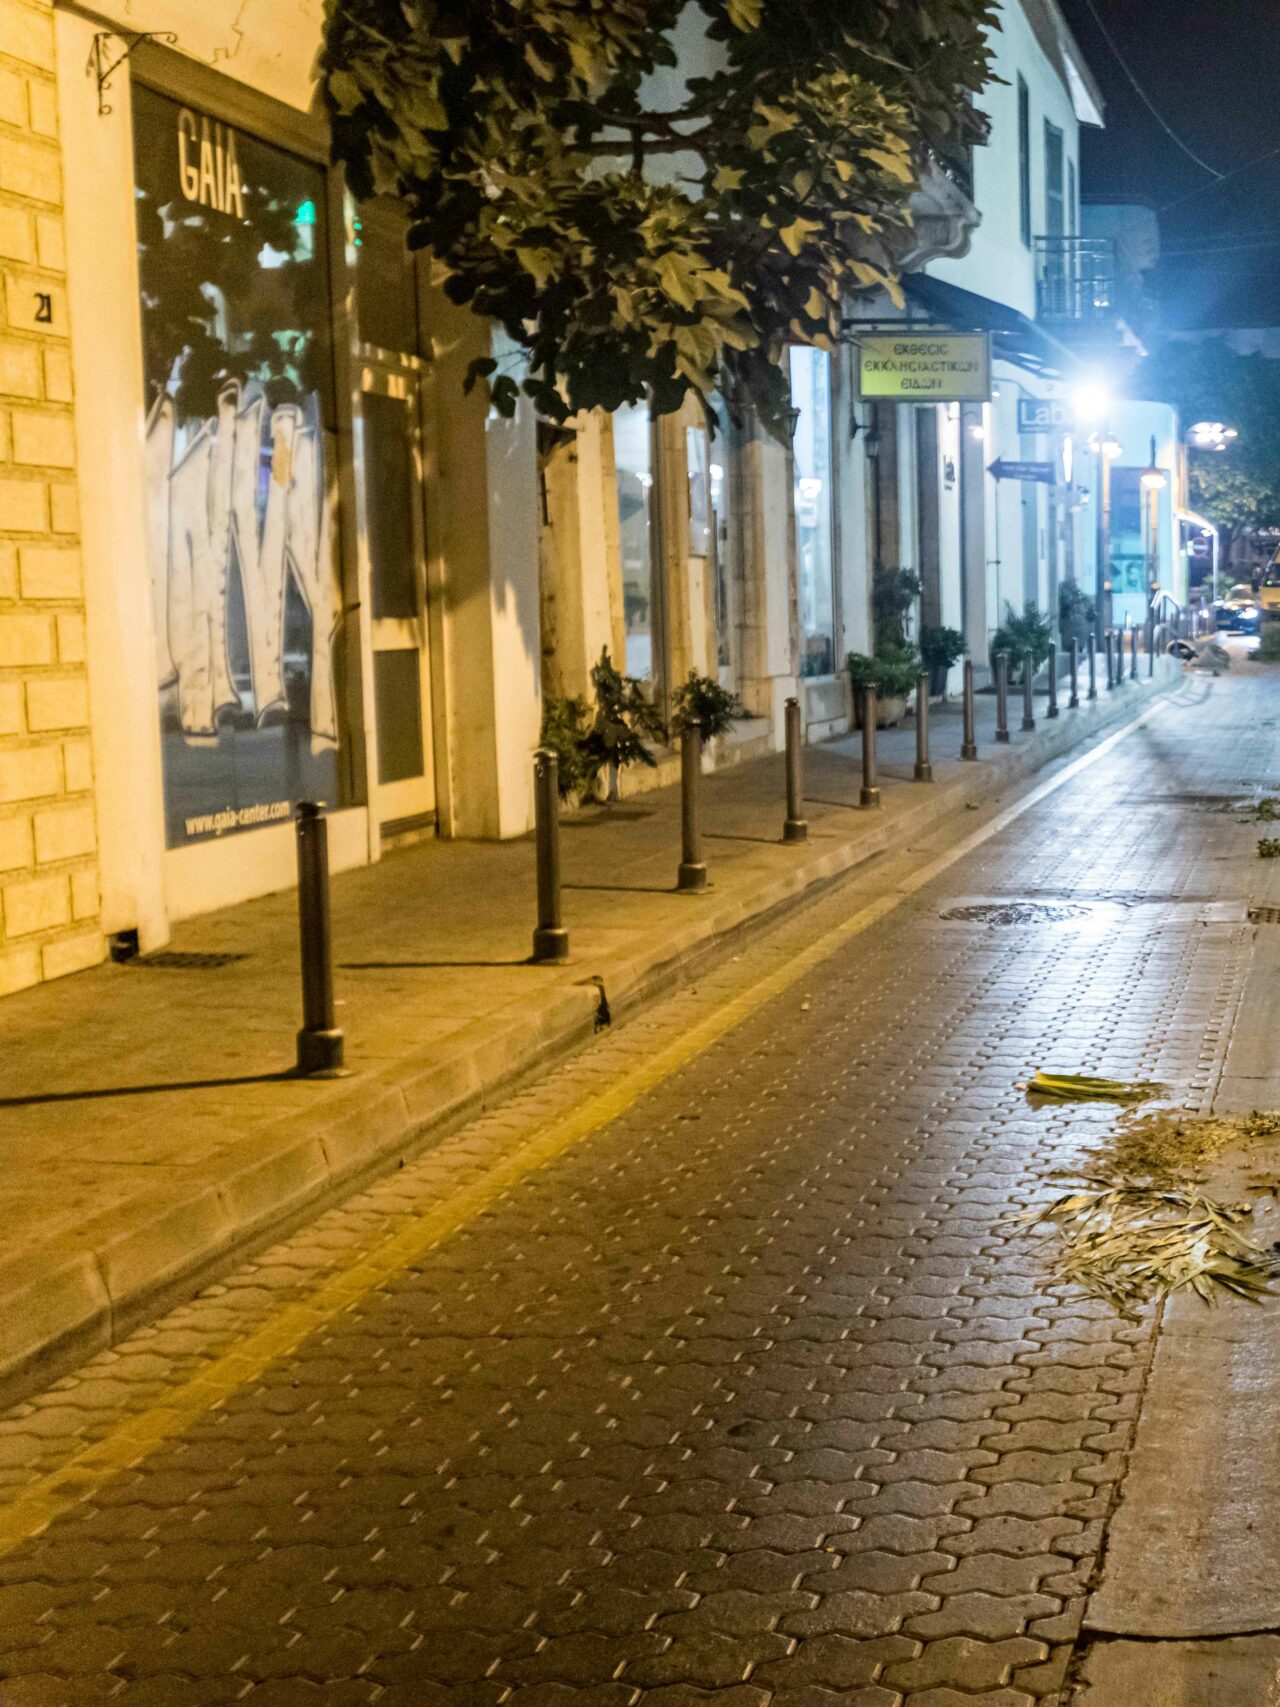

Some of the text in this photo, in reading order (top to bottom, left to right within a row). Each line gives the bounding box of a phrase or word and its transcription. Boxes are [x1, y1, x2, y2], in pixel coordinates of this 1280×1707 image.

[178, 107, 243, 219] GAIA
[33, 292, 52, 324] 21
[185, 801, 290, 836] www.gaia-center.com
